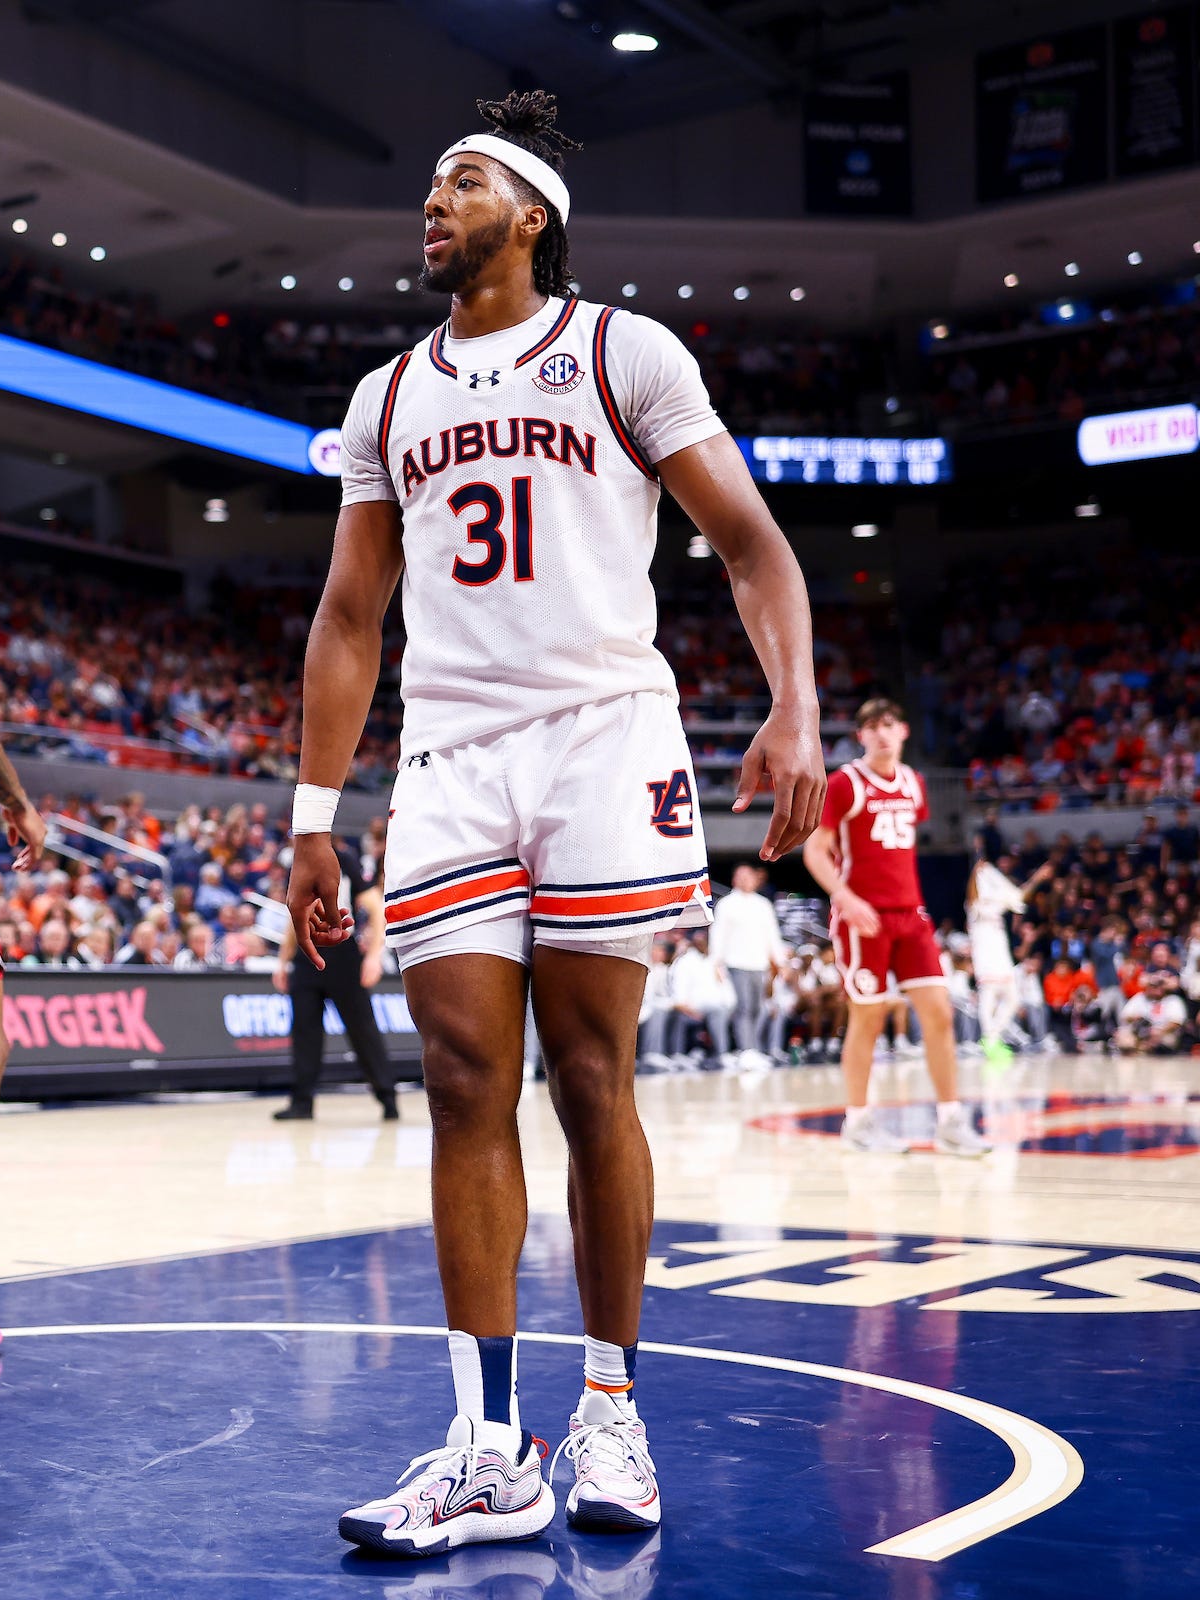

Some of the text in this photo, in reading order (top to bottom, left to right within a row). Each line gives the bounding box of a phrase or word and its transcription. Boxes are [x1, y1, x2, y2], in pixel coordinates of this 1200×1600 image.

[538, 380, 578, 393] GRADUATE
[542, 354, 577, 385] SEC
[1167, 418, 1197, 441] OU
[402, 417, 597, 497] AUBURN
[447, 476, 534, 587] 31
[870, 811, 917, 850] 45
[2, 986, 165, 1054] ATGEEK
